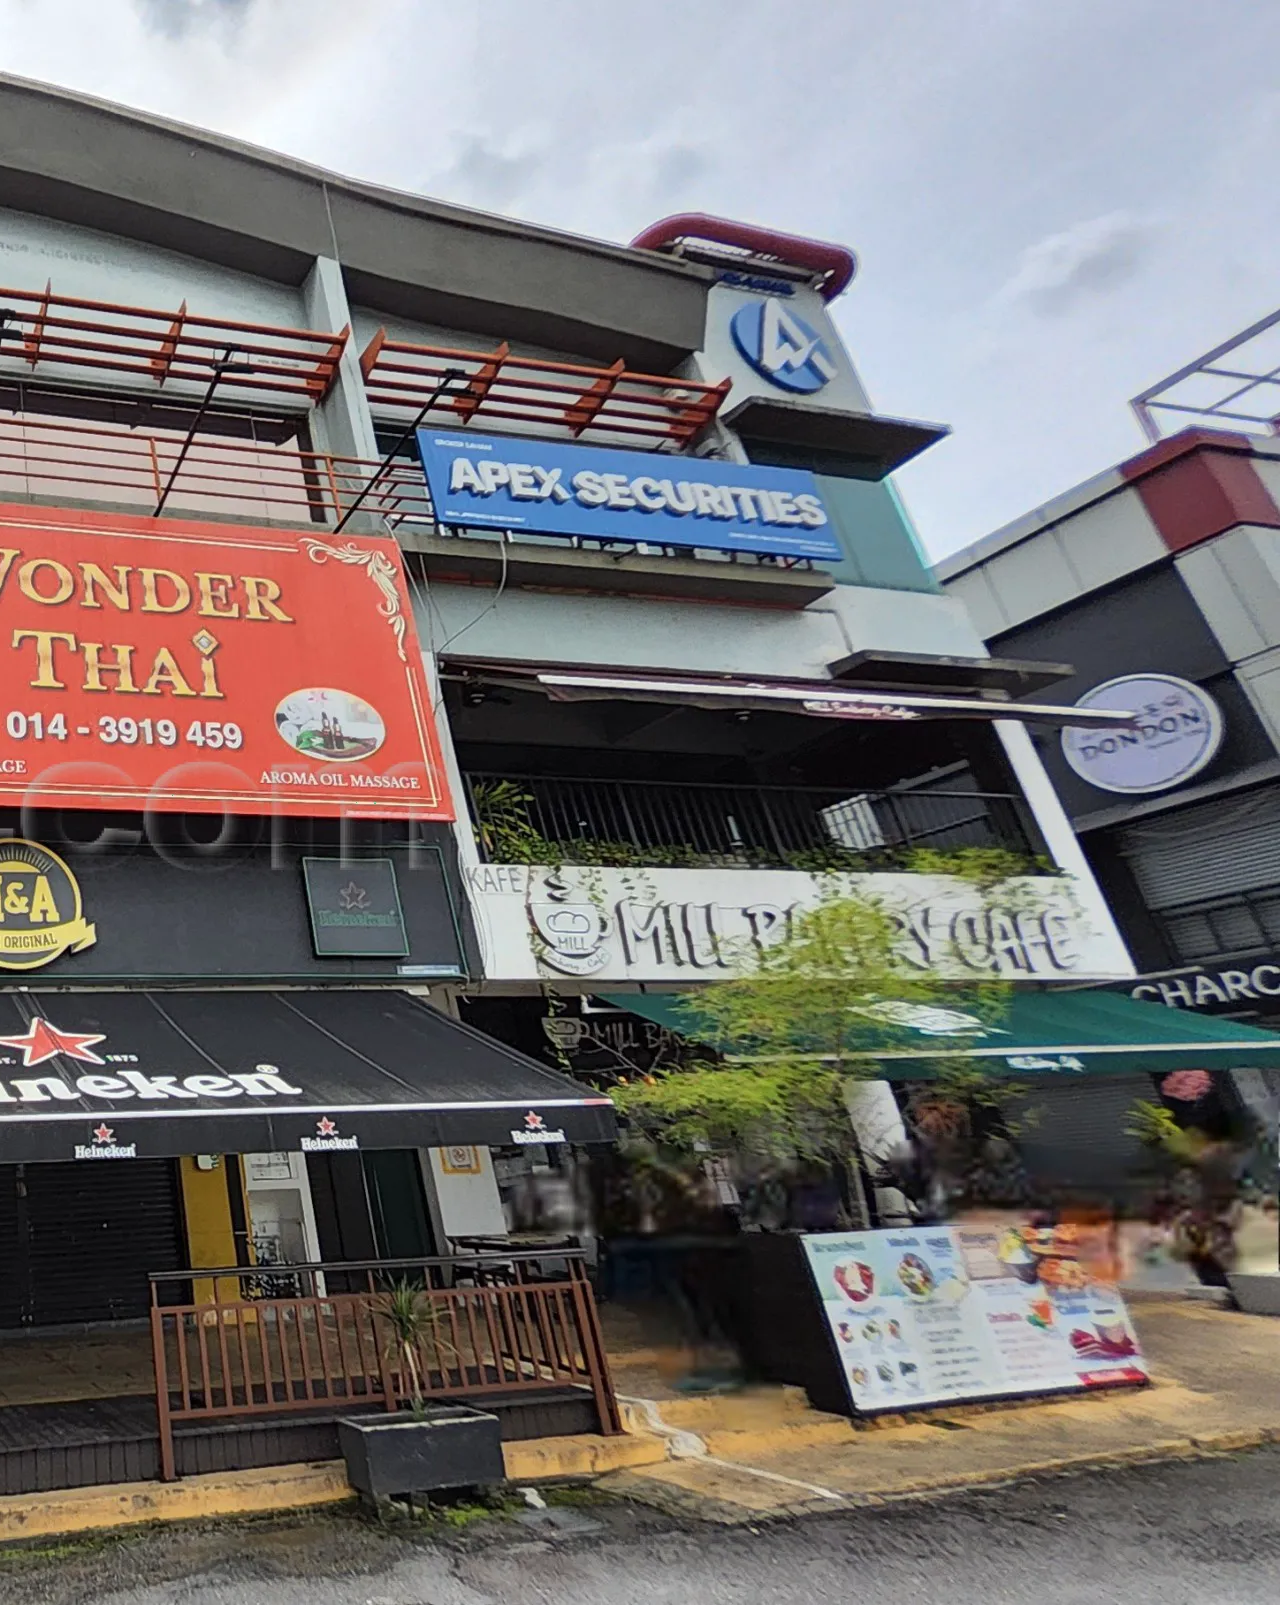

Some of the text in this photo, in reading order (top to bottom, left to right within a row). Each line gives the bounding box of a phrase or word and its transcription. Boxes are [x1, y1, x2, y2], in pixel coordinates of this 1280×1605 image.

[448, 457, 828, 530] APEX SECURITIES
[6, 710, 68, 741] 014
[98, 715, 177, 747] 3919
[186, 720, 243, 750] 459
[259, 771, 421, 790] AROMA OIL MASSAGE
[464, 866, 523, 893] KAFE
[4, 932, 59, 949] ORIGINAL
[557, 936, 589, 951] MILL
[615, 899, 729, 968] MILL
[593, 1021, 640, 1048] MILL
[74, 1143, 137, 1160] Heineken
[301, 1136, 359, 1151] Heineken
